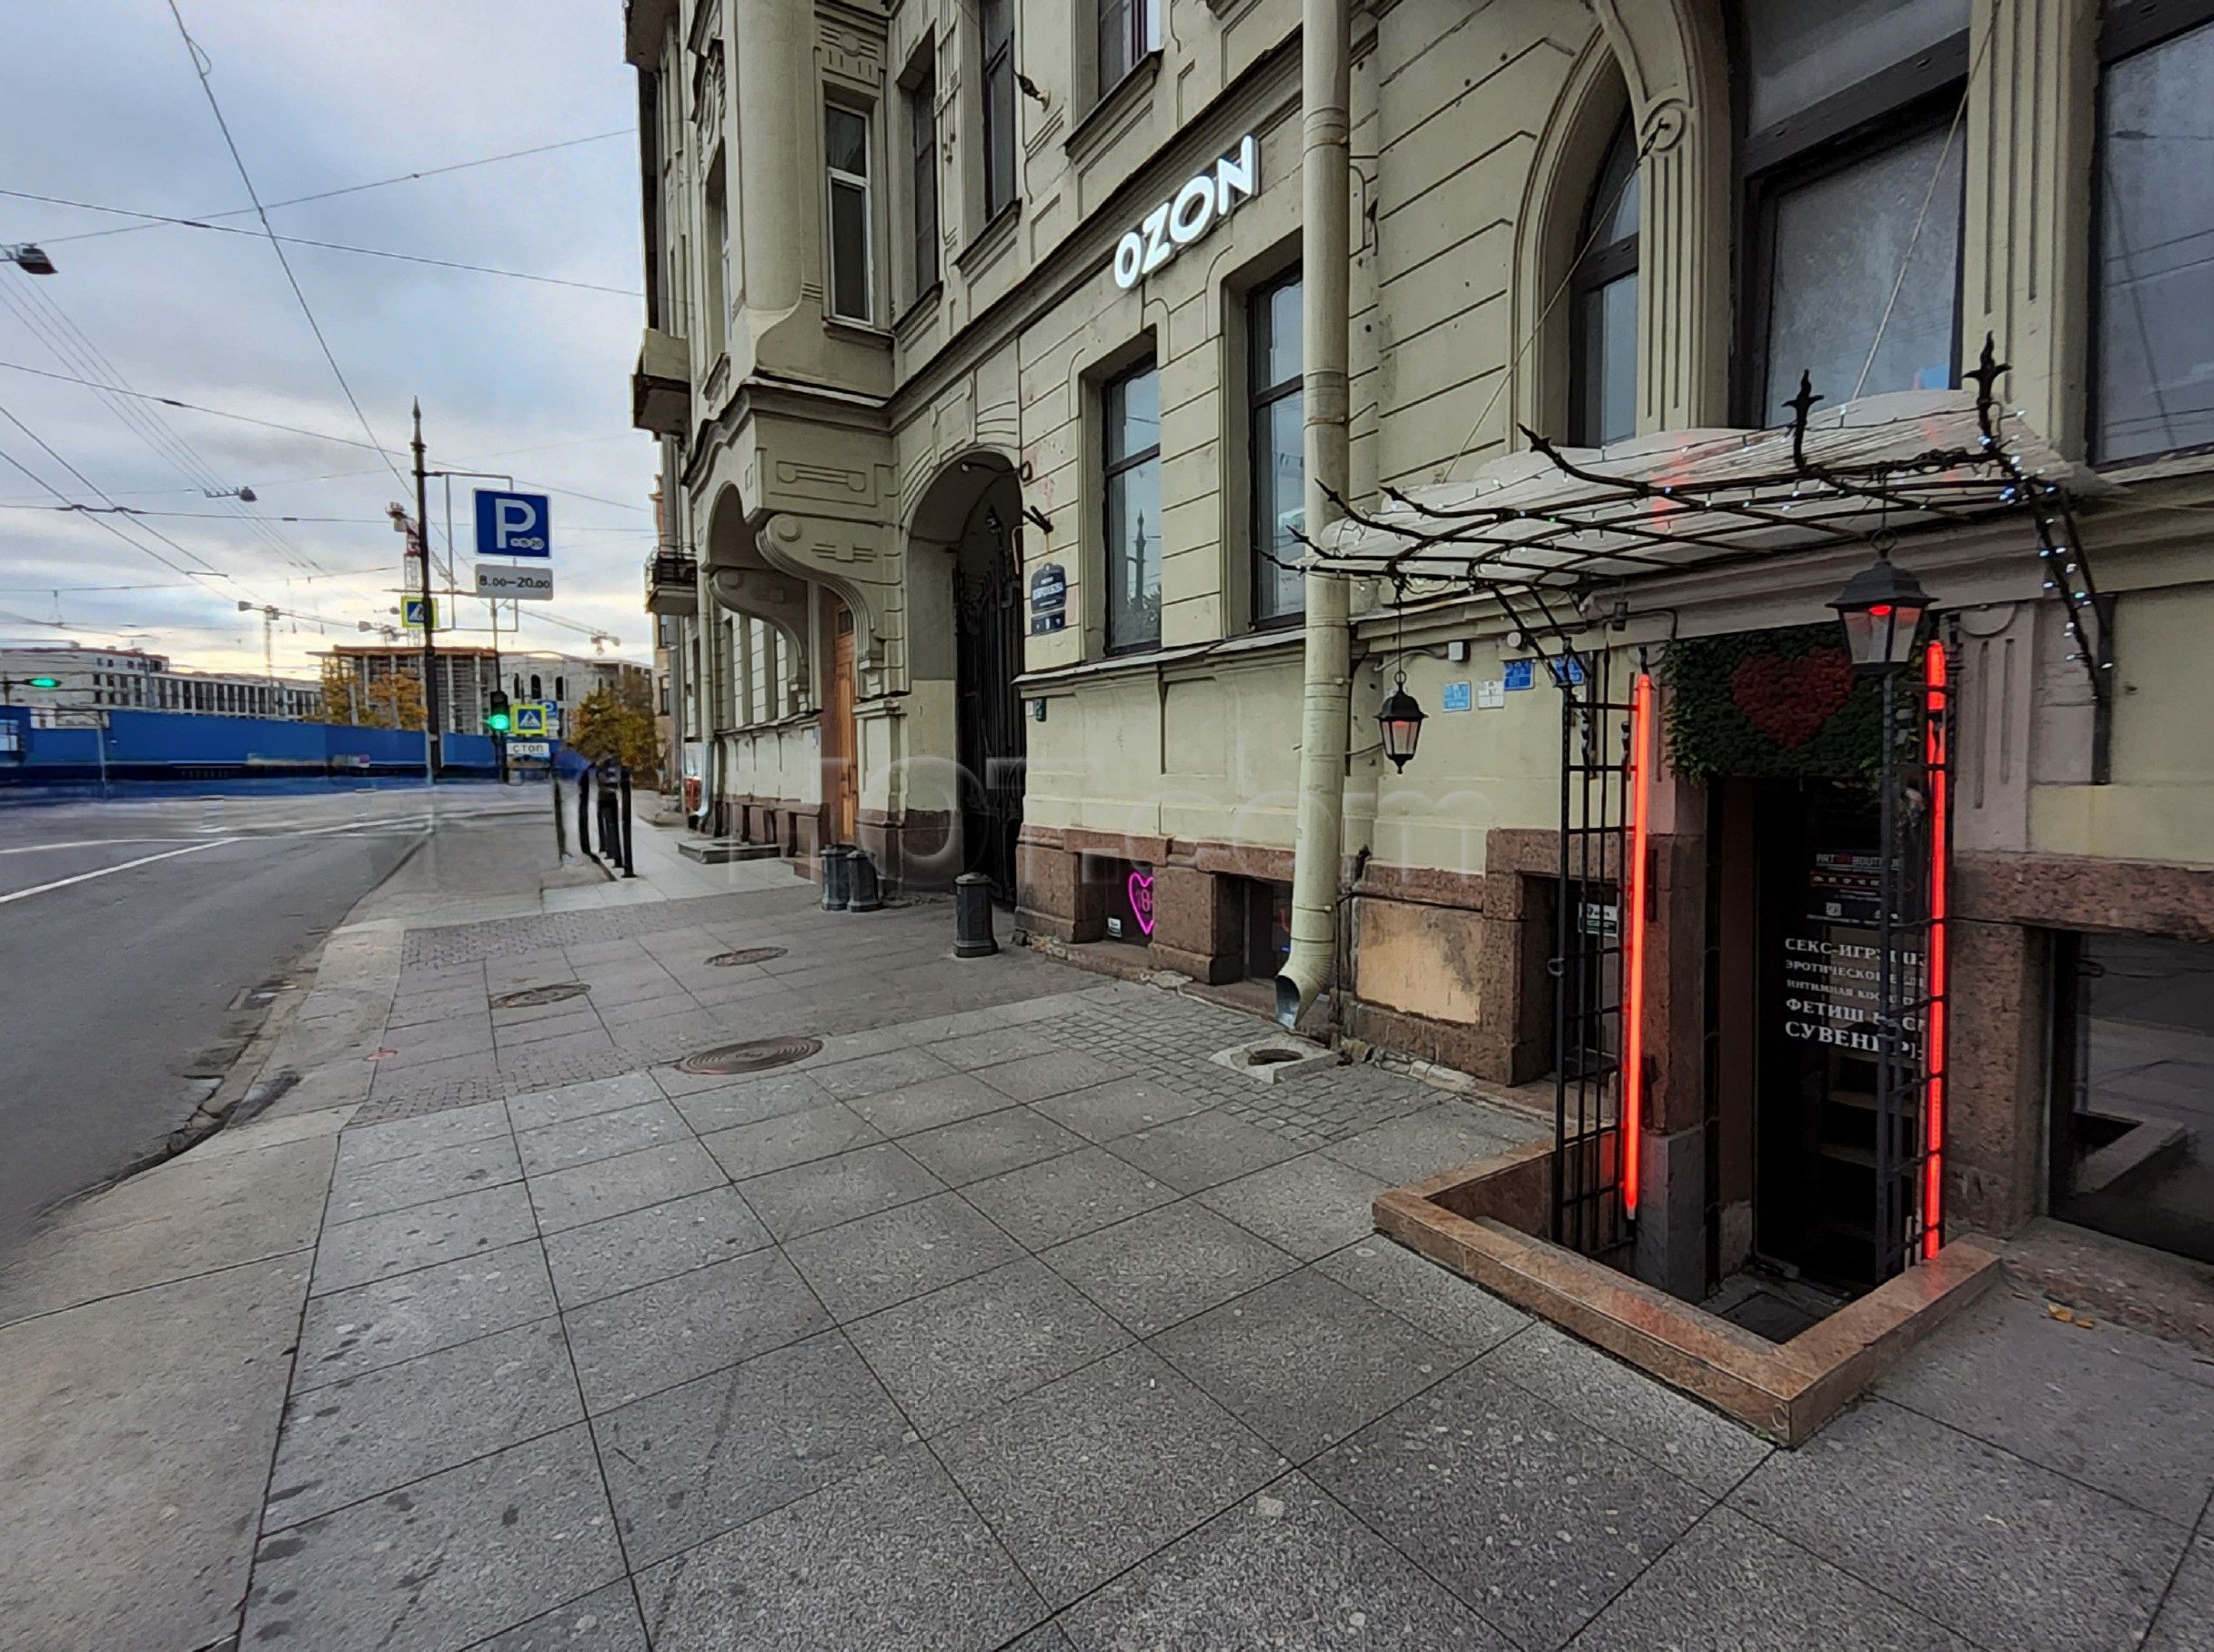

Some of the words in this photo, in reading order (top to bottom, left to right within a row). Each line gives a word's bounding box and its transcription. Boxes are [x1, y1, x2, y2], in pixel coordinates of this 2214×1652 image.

[1113, 132, 1261, 289] OZON
[495, 498, 537, 549] P
[1786, 998, 1865, 1022] ФЕТИШ
